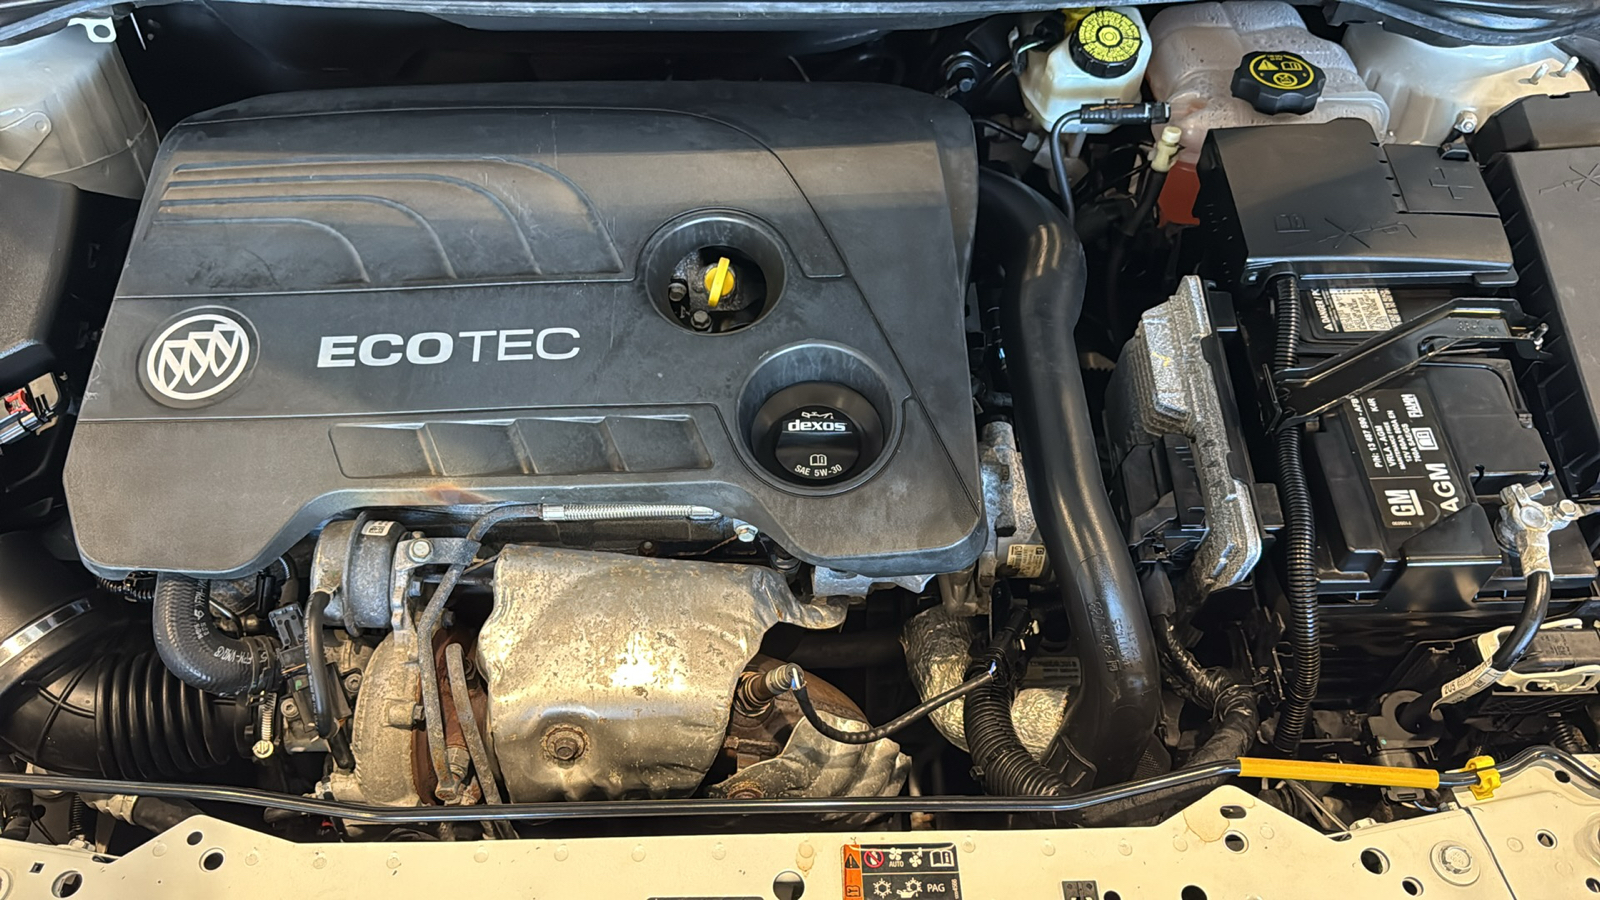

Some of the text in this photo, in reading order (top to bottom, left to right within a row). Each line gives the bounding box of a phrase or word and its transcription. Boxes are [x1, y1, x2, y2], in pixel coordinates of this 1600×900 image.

[1315, 301, 1331, 323] DANGER
[317, 327, 582, 368] ECOTEC
[788, 419, 846, 431] dexos
[1374, 425, 1388, 442] AGM
[1383, 446, 1397, 467] VRLA
[794, 464, 843, 477] SAE 5W-30
[1424, 463, 1460, 512] AGM
[1384, 489, 1417, 517] GM
[927, 883, 946, 893] PAG
